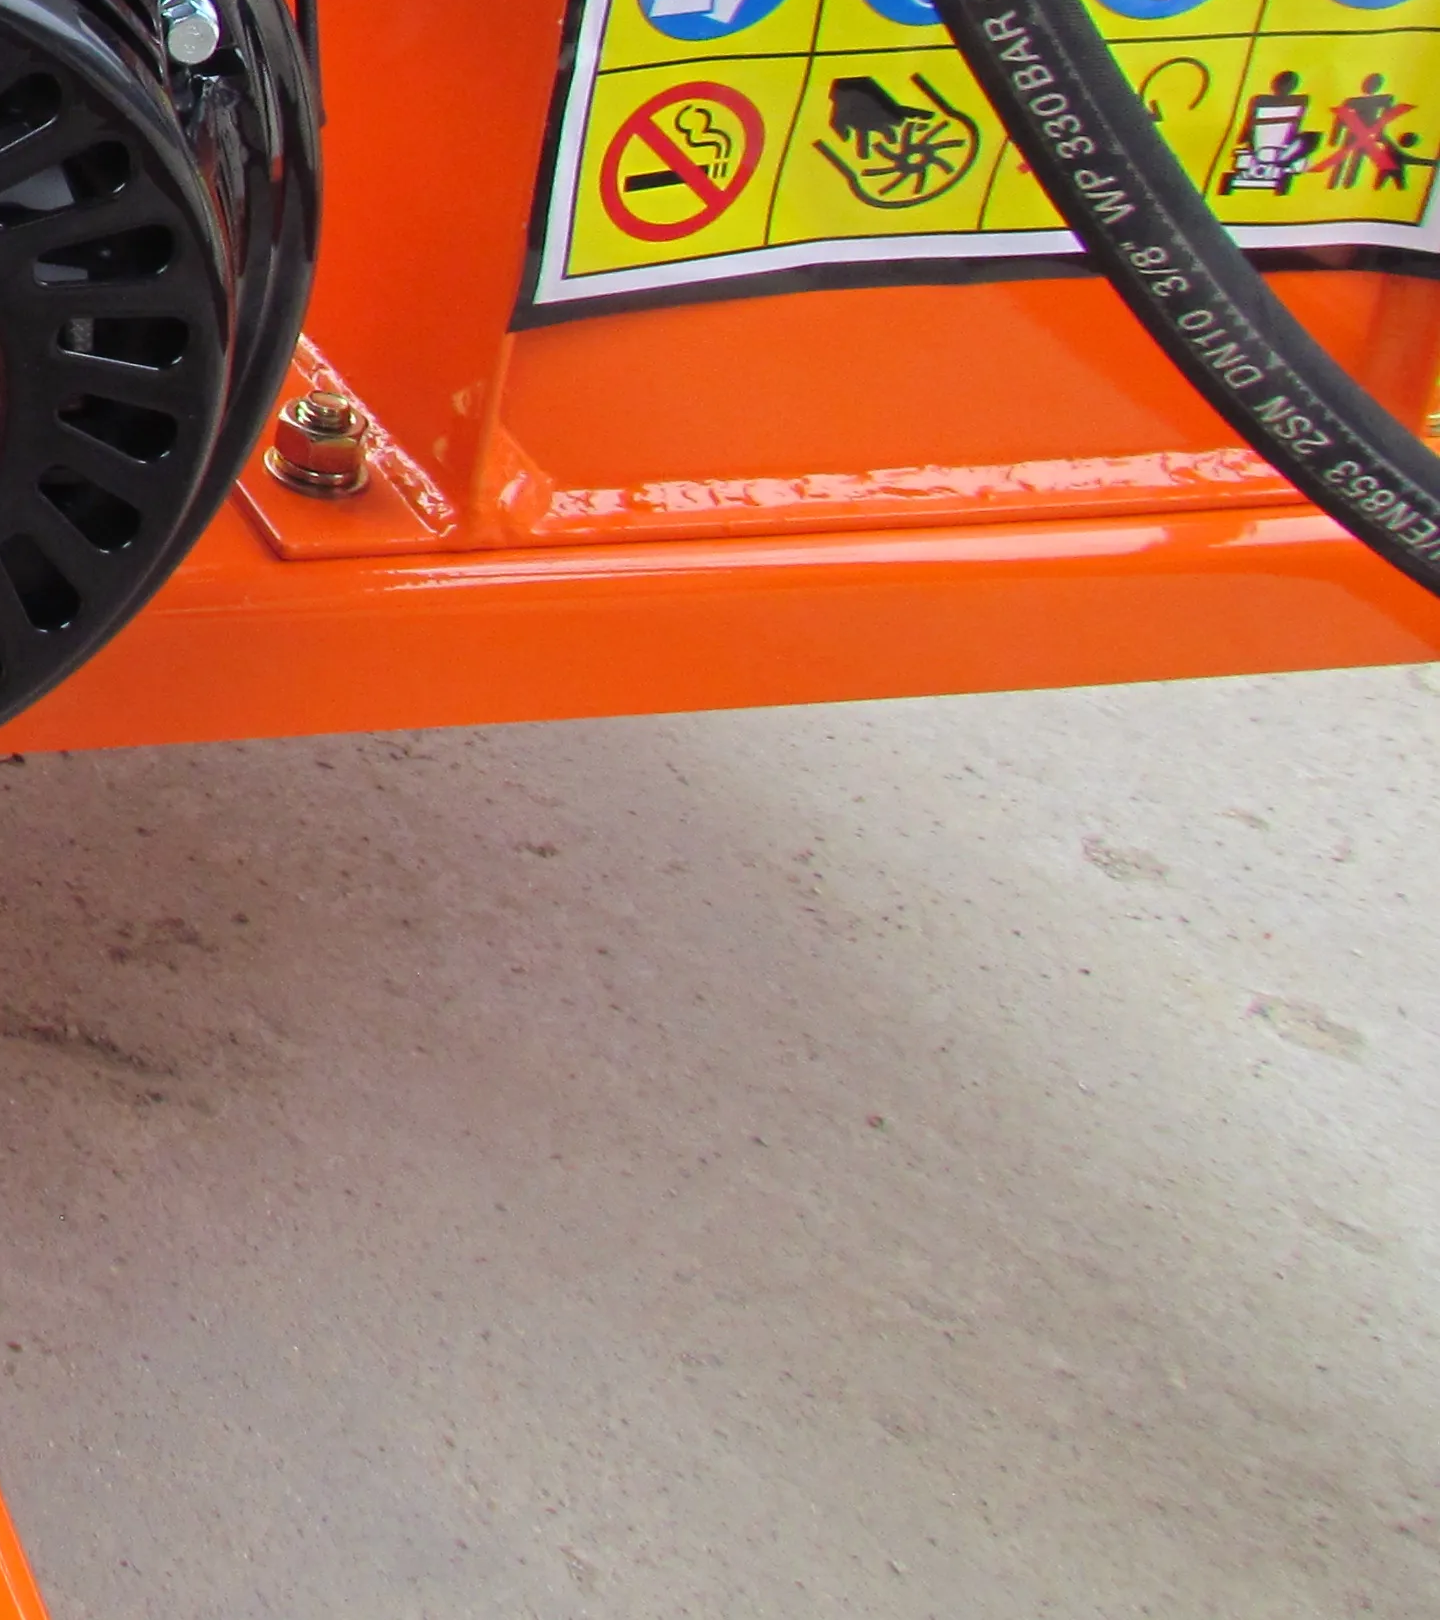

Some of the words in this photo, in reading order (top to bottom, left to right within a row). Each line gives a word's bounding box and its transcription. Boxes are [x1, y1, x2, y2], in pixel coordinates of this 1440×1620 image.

[1073, 169, 1137, 225] WP
[1177, 310, 1265, 390] DN10
[1254, 395, 1332, 455] 2SN
